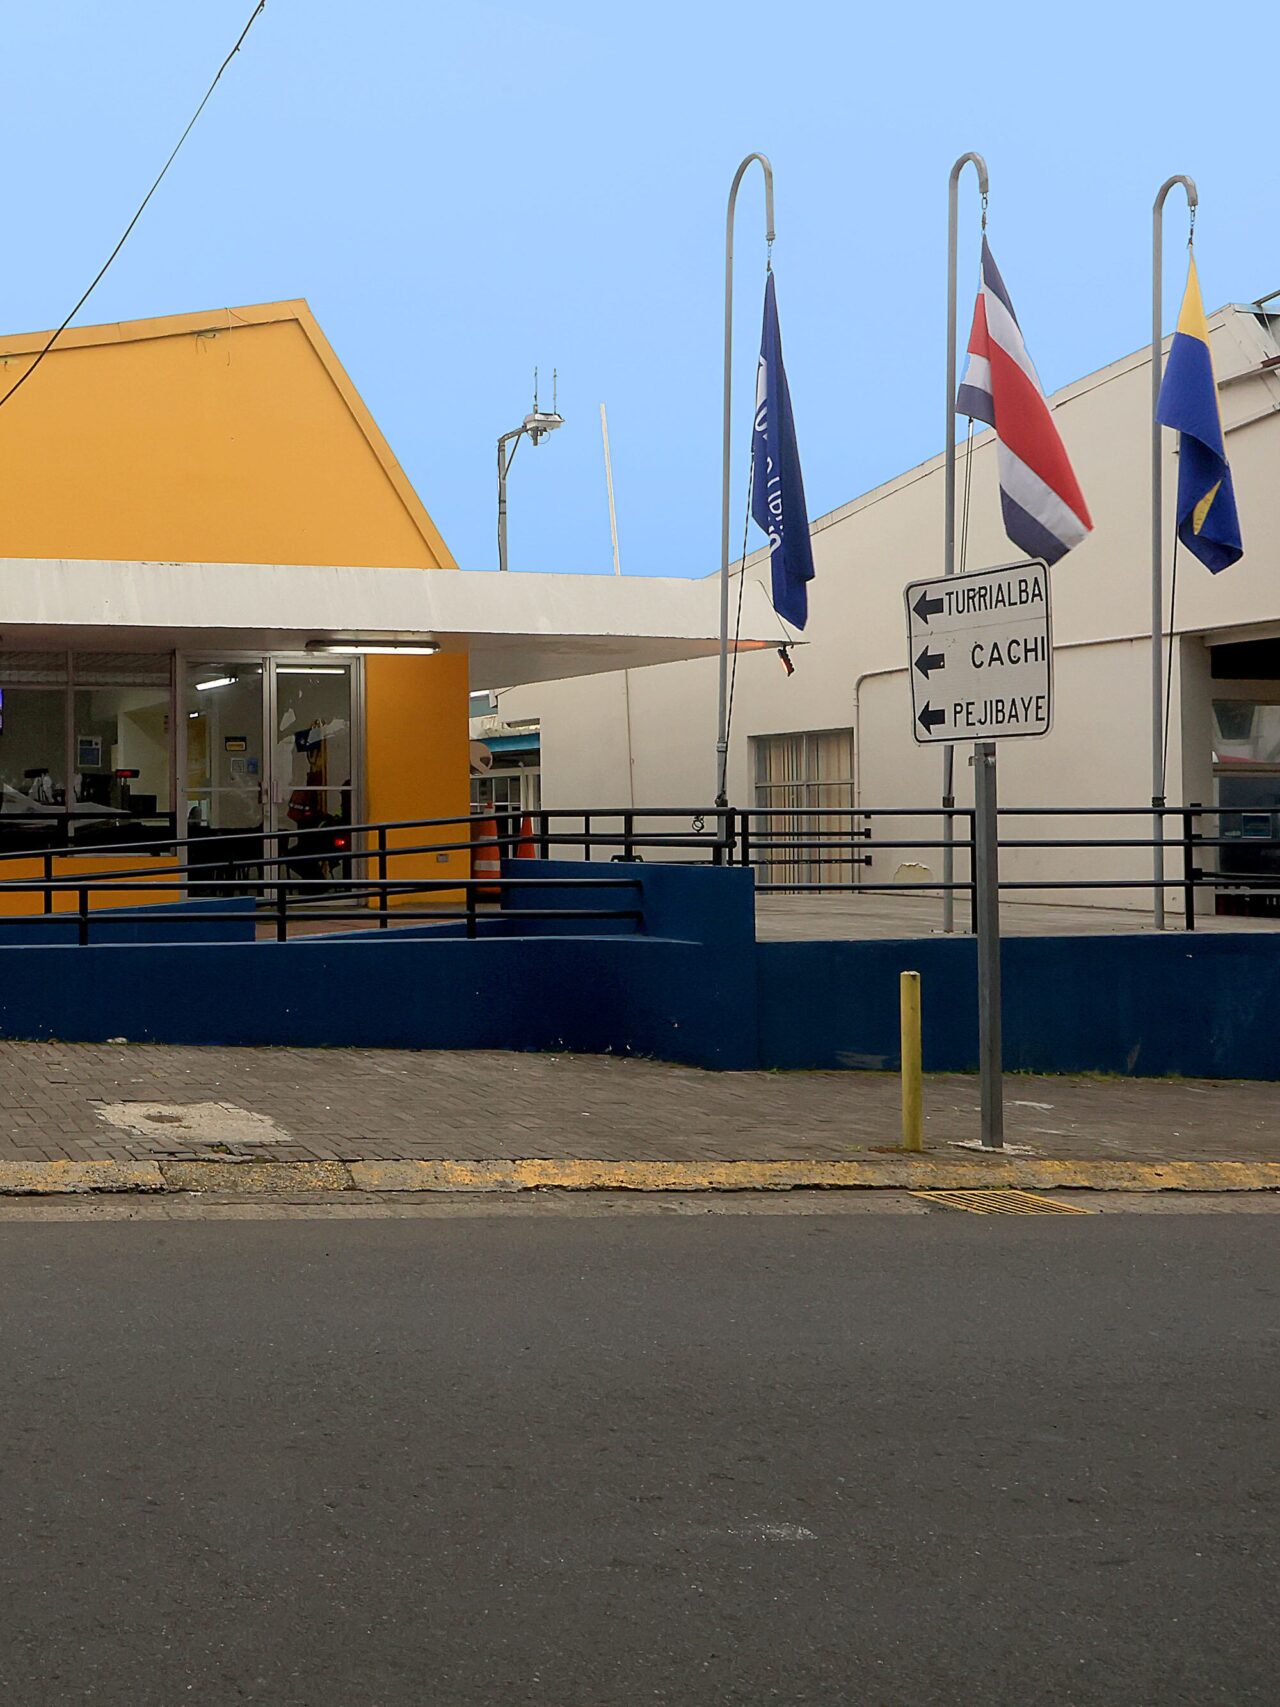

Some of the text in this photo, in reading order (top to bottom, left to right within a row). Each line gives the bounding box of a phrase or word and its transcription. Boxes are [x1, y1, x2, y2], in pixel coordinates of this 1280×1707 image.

[945, 576, 1044, 616] TURRIALBA
[971, 636, 1046, 669] CACHI
[953, 695, 1046, 728] PEJIBAYE
